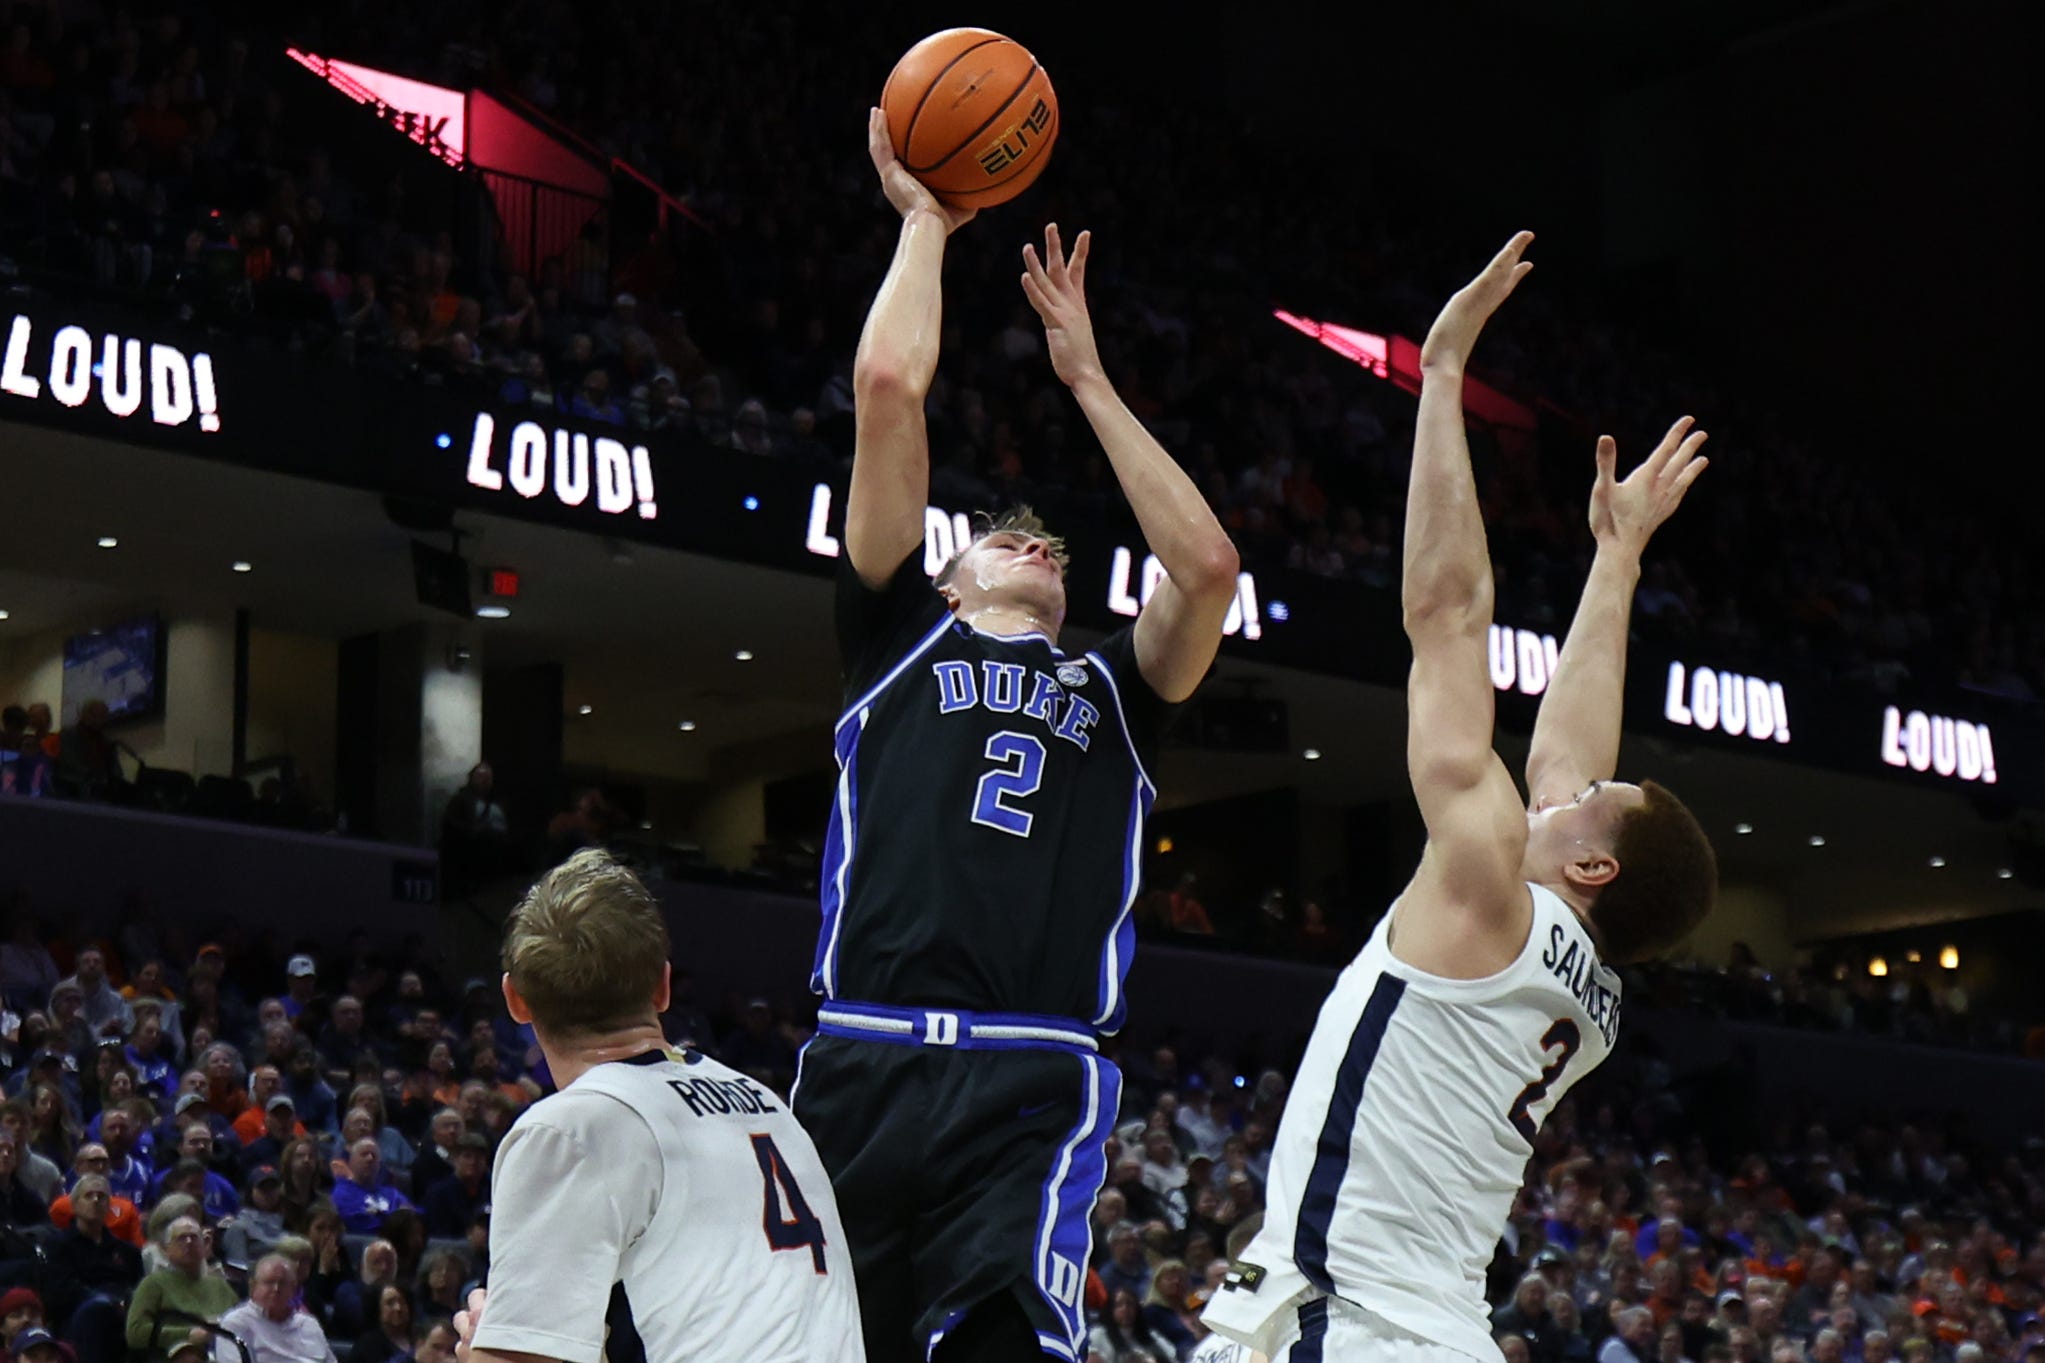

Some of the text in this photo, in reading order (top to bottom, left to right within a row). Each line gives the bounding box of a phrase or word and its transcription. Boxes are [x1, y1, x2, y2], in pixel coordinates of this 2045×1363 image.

[980, 98, 1050, 176] ELITE
[1, 315, 220, 433] LOUD!
[467, 412, 657, 520] LOUD!
[806, 483, 973, 577] LD!
[933, 660, 1100, 752] DUKE
[1665, 660, 1790, 744] LOUD!
[1881, 705, 1997, 784] LOUD!
[970, 730, 1047, 839] 2
[1509, 1017, 1581, 1145] 2
[748, 1132, 828, 1276] 4
